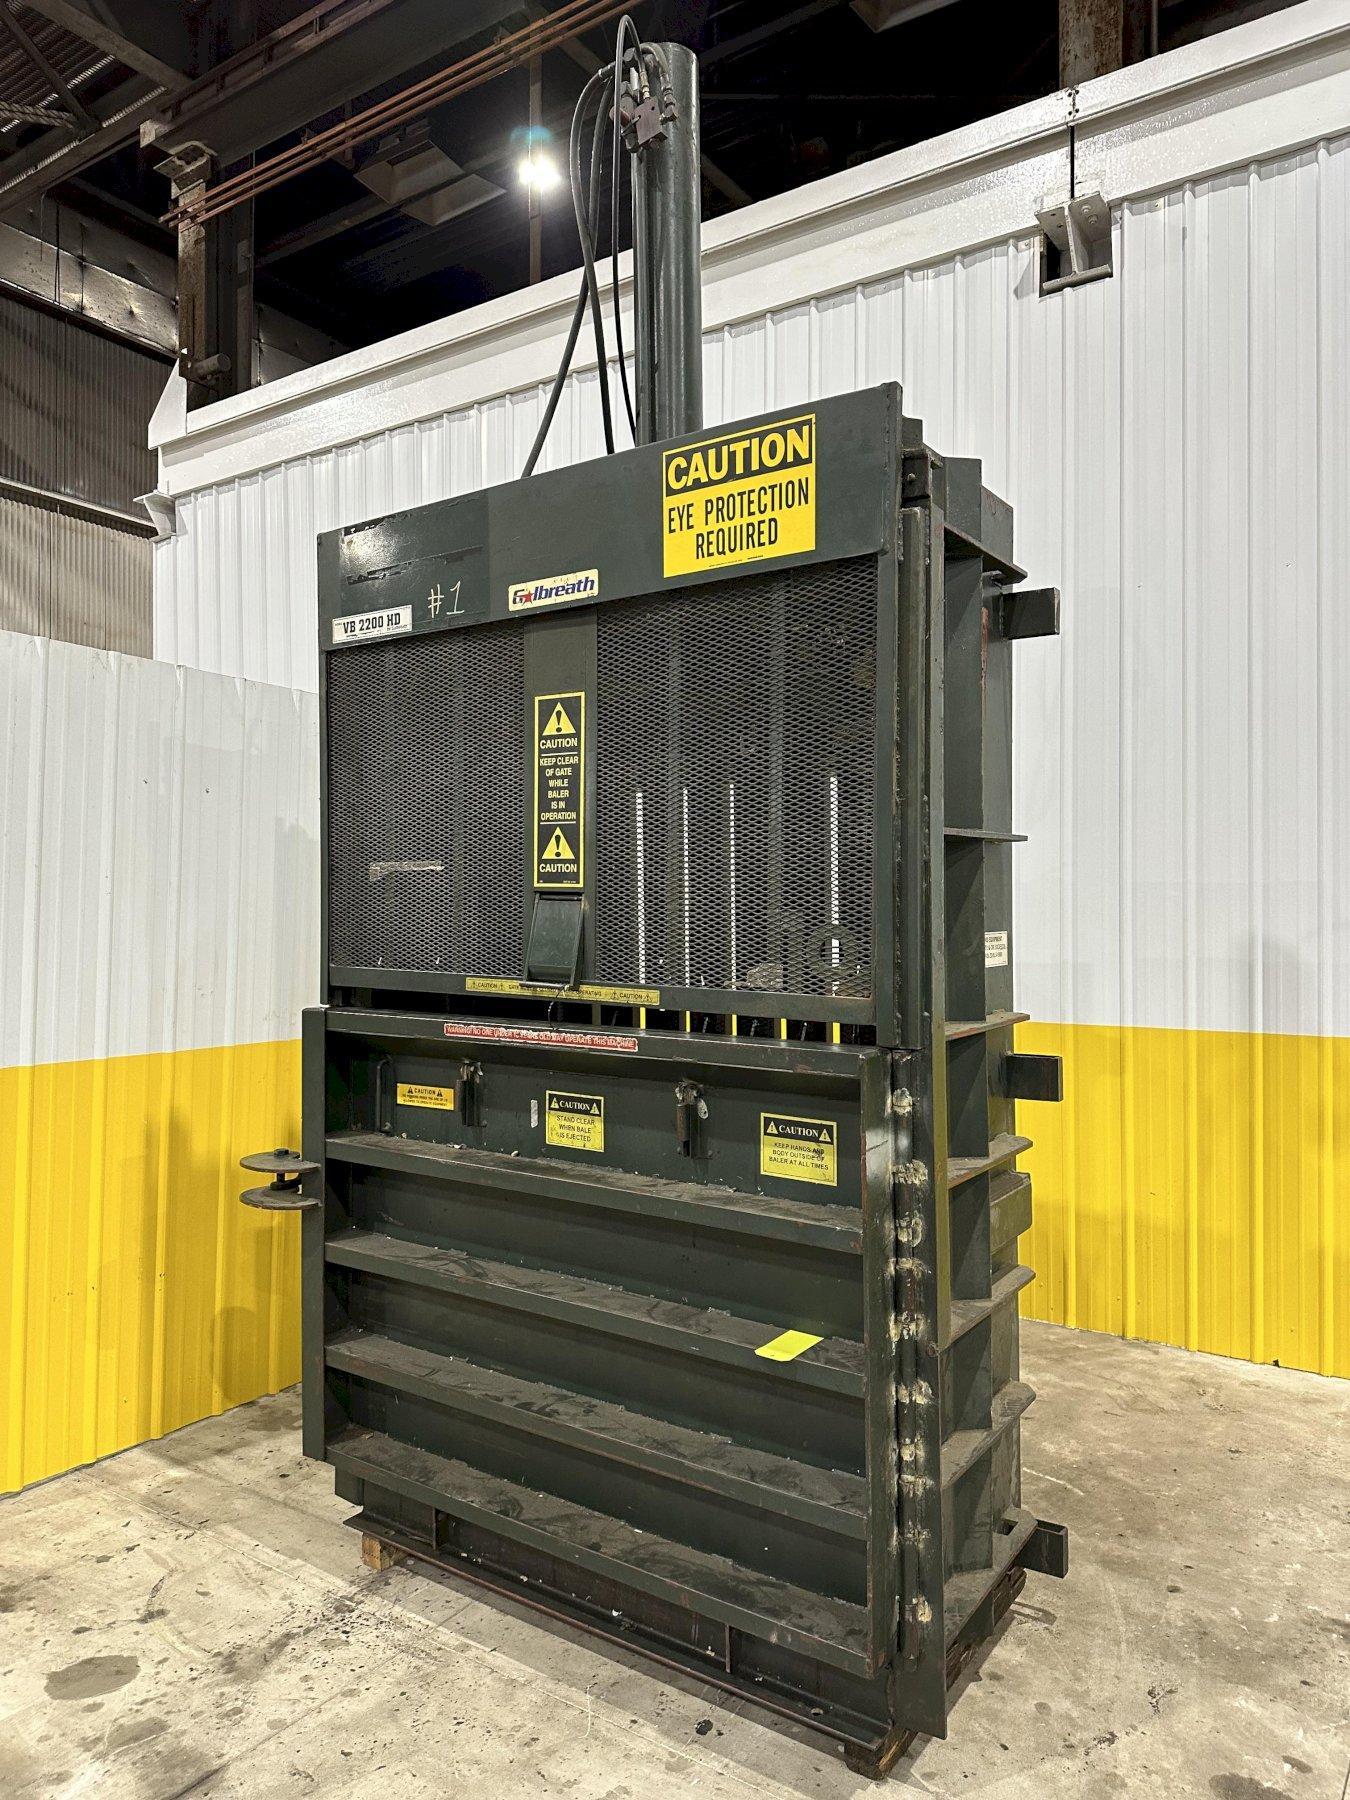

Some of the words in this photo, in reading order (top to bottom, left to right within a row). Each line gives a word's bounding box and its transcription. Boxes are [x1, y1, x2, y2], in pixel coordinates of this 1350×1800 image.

[668, 424, 810, 490] CAUTION
[668, 502, 695, 534] EYE
[704, 476, 809, 526] PROTECTION
[695, 517, 778, 560] REQUIRED
[512, 576, 595, 606] Glbreath
[343, 620, 356, 634] VB
[358, 615, 384, 631] 2200
[386, 612, 401, 627] HD
[539, 737, 578, 749] CAUTION
[539, 757, 556, 766] KEEP
[556, 756, 579, 765] CLEAR
[545, 768, 555, 777] OF
[555, 767, 572, 776] GATE
[548, 779, 569, 787] WHILE
[547, 790, 570, 799] BALER
[551, 801, 558, 809] IS
[558, 801, 566, 809] IN
[540, 811, 577, 821] OPERATION
[539, 863, 577, 873] CAUTION
[473, 1027, 481, 1035] NO
[481, 1028, 493, 1036] ONE
[414, 1087, 436, 1095] CAUTION
[559, 1100, 590, 1110] CAUTION
[556, 1114, 575, 1123] STAND
[576, 1117, 595, 1126] CLEAR
[559, 1123, 575, 1131] WHEN
[576, 1126, 592, 1134] BALE
[778, 1124, 819, 1138] CAUTION
[565, 1133, 592, 1142] EJECTED
[790, 1144, 811, 1153] HANDS
[772, 1149, 789, 1157] BODY
[789, 1152, 815, 1161] OUTSIDE
[768, 1156, 789, 1164] BALER
[798, 1160, 809, 1168] ALL
[810, 1162, 829, 1171] TIMES
